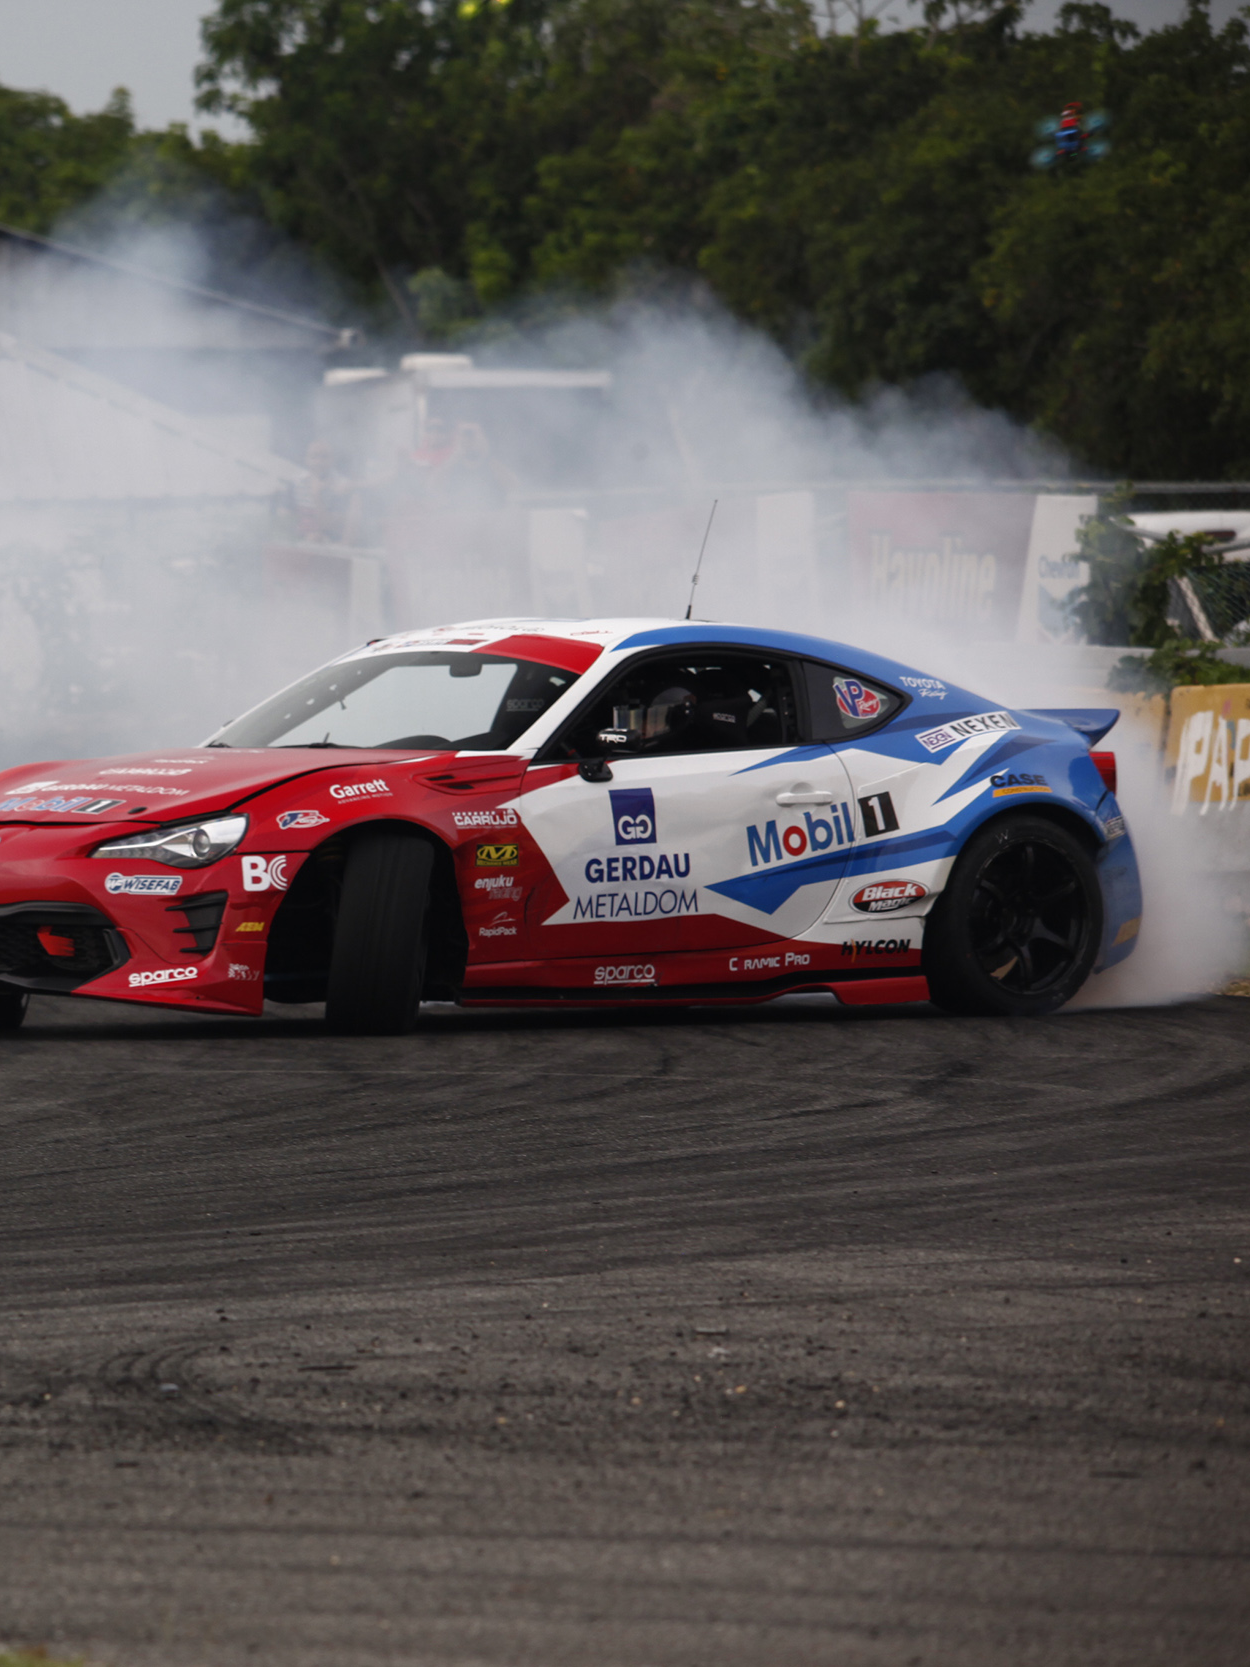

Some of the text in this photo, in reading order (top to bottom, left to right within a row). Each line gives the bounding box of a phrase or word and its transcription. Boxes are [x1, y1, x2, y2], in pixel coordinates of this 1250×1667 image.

[899, 676, 946, 690] TOYOTA
[833, 680, 865, 718] VP
[950, 713, 1019, 737] NEXEN
[329, 778, 390, 799] Garrett
[990, 773, 1049, 788] CASE
[453, 814, 518, 826] CARRUJO
[746, 796, 886, 867] Mobil 1
[584, 852, 691, 883] GERDAU
[123, 879, 181, 892] WISEFAB
[474, 874, 514, 891] enjuku
[861, 883, 918, 902] Black
[573, 888, 699, 920] METALDOM
[479, 926, 517, 938] RapidPack
[841, 938, 911, 956] HYLCON
[128, 966, 198, 987] sparco
[594, 964, 655, 985] sparco
